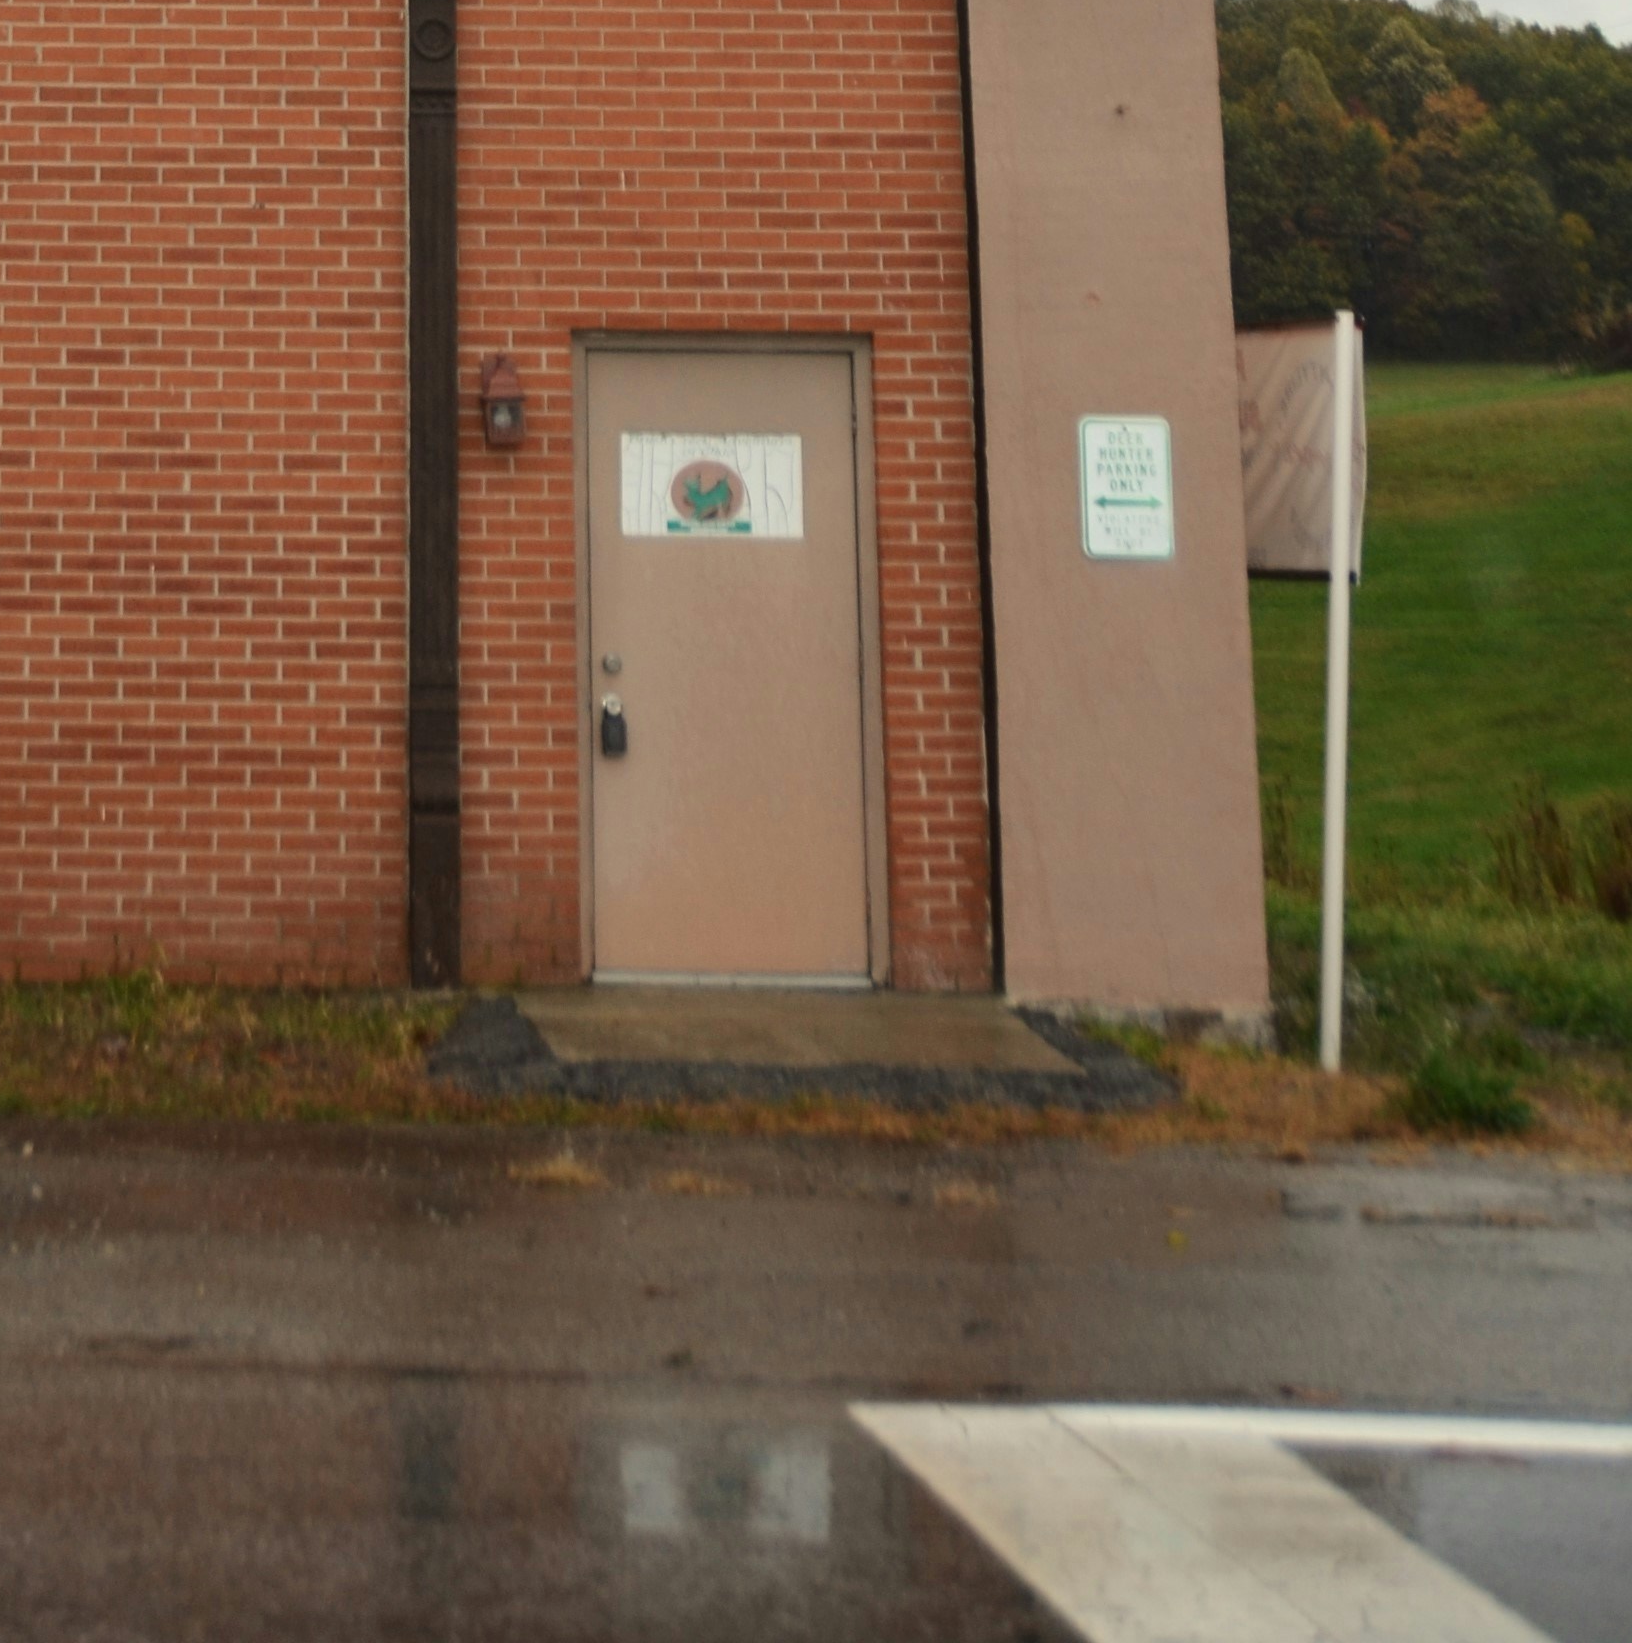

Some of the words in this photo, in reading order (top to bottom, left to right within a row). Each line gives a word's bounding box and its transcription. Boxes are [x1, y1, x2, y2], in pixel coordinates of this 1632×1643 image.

[1108, 431, 1144, 445] DEER
[1098, 447, 1153, 461] HUNTER
[1096, 463, 1157, 477] PARKING
[1109, 478, 1144, 492] ONLY
